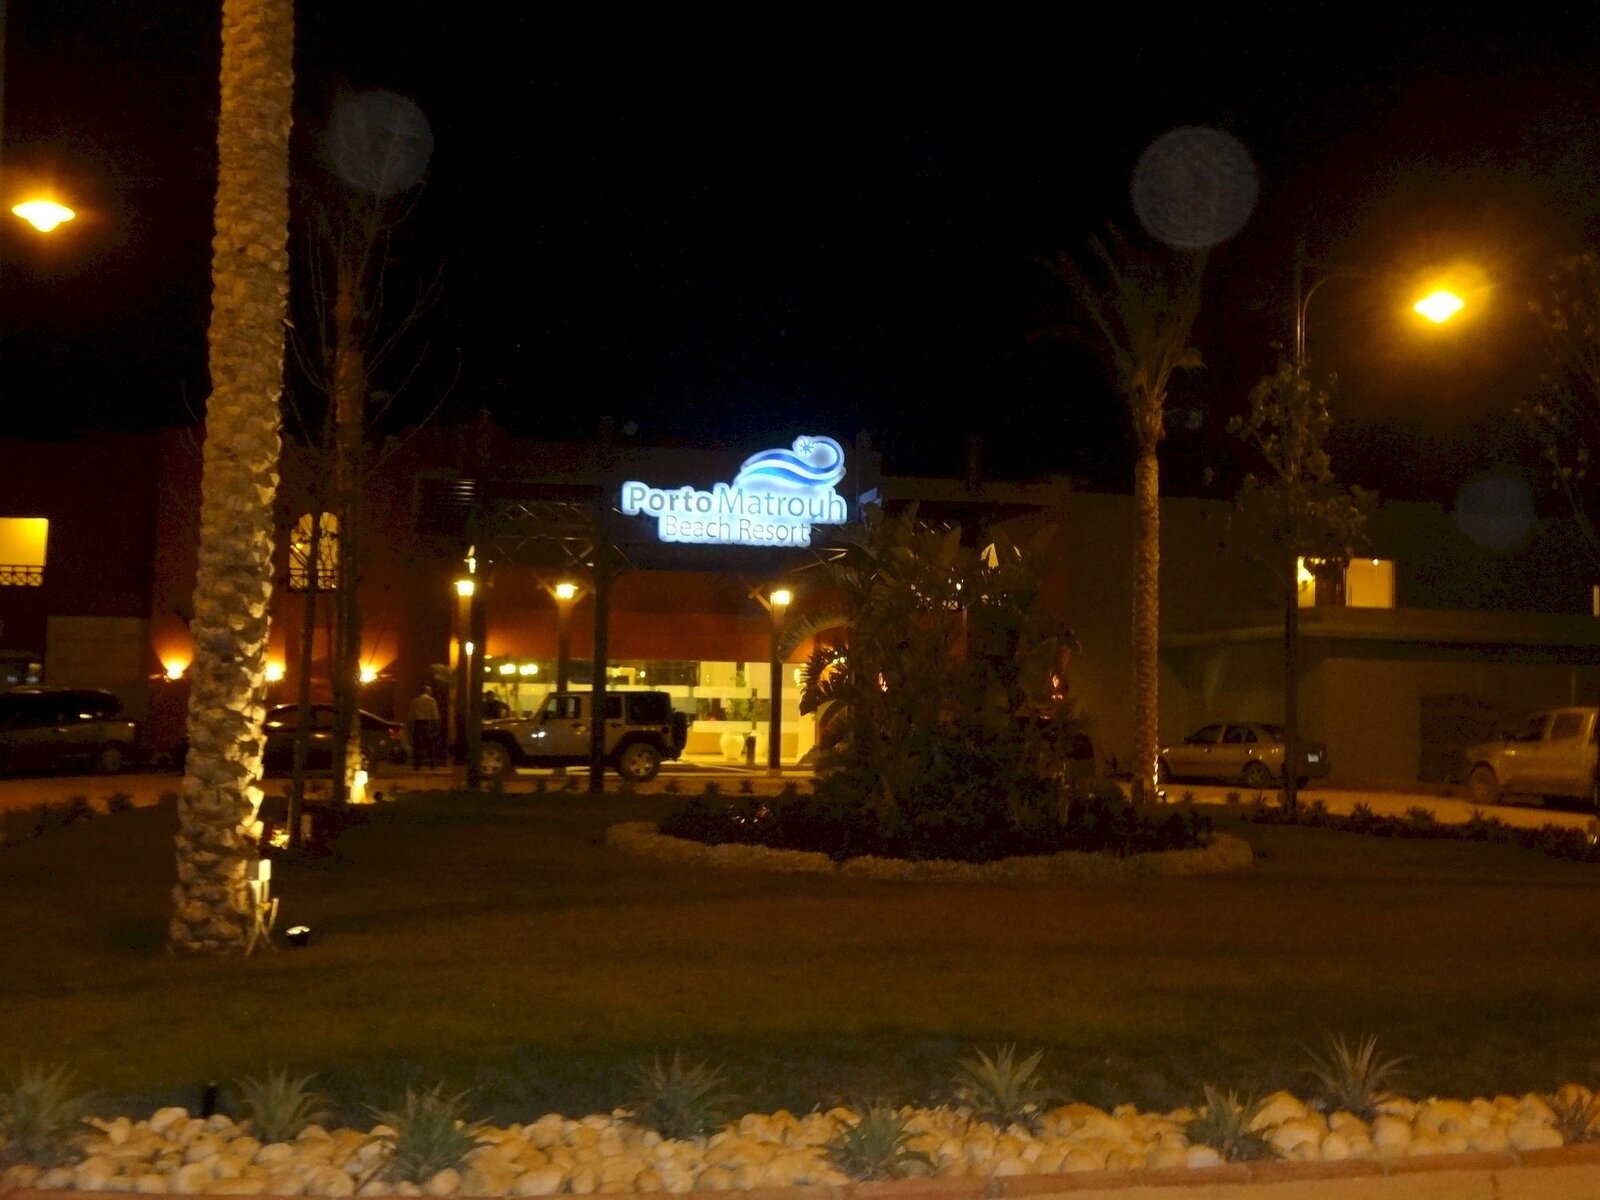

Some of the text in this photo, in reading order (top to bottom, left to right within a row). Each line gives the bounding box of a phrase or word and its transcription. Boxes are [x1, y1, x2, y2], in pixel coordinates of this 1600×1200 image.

[629, 486, 844, 520] Porto Matrouh
[665, 515, 808, 542] Beach Resort
